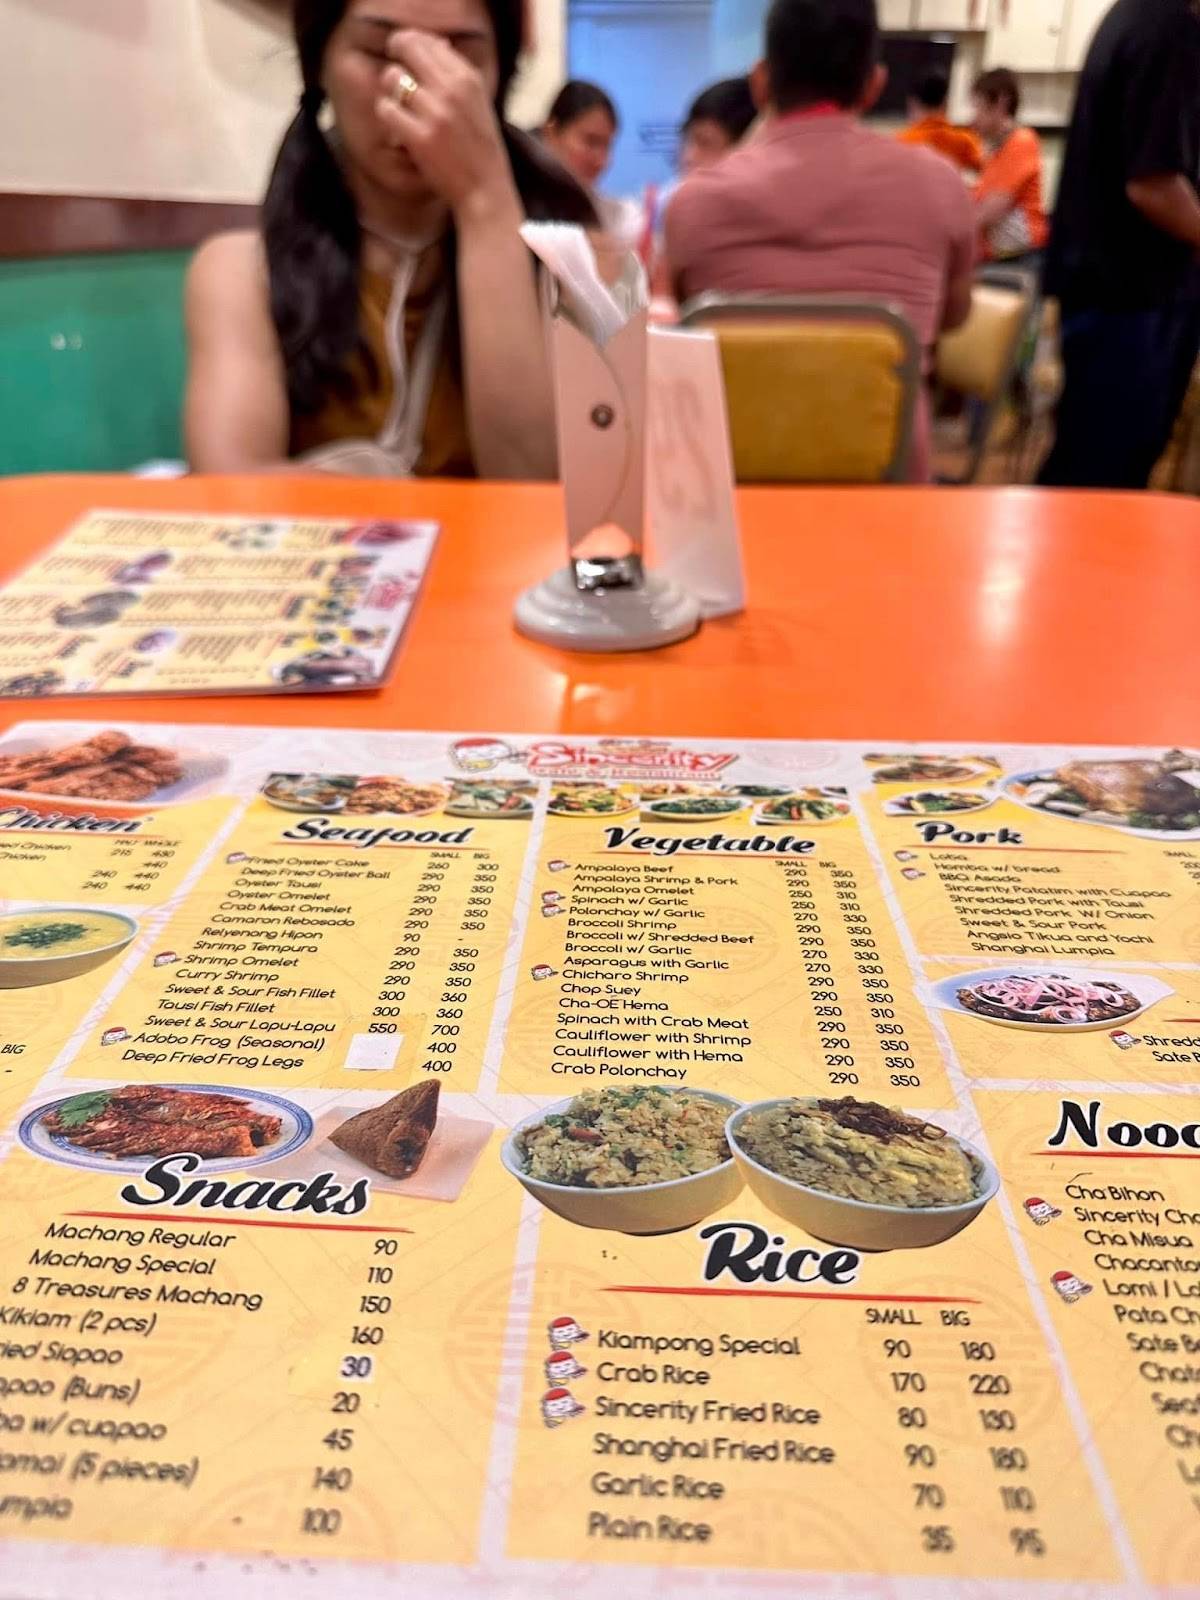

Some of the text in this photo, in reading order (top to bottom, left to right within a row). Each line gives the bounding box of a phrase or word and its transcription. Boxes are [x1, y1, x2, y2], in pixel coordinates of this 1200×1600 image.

[0, 806, 143, 832] Chicken
[283, 819, 474, 850] Seafood
[604, 827, 815, 856] Vegetable
[915, 821, 1022, 844] Pork
[944, 883, 1010, 894] Sincerity
[1075, 888, 1108, 896] with
[219, 901, 352, 914] Crab Meat Omelet
[571, 895, 688, 907] Spinach w/ Garlic
[211, 914, 355, 927] Camaron Rebosado
[569, 906, 705, 918] Polonchay w/ Garlic
[568, 918, 677, 931] Broccoli Shrimp
[960, 917, 1107, 930] Sweet & Sour Pork
[201, 927, 323, 940] Relyenong Hipon
[566, 930, 754, 944] Broccoli w/ Shredded Beef
[193, 940, 318, 954] Shrimp Tempura
[971, 942, 1115, 956] Shanghai Lumpia
[184, 954, 299, 967] Shrimp Omelet
[388, 960, 475, 972] 290 350
[563, 956, 729, 969] Asparagus with Garlic
[175, 969, 279, 983] Curry Shrimp
[562, 969, 689, 984] Chicharo Shrimp
[164, 983, 336, 998] Sweet & Sour Fish Fillet
[378, 991, 467, 1003] 300 360
[560, 983, 641, 997] Chop Suey
[158, 999, 276, 1013] Tausi Fish Fillet
[559, 997, 669, 1011] Cha-OE Hema
[144, 1015, 336, 1034] Sweet & Sour Lapu-Lapu
[368, 1023, 460, 1036] 550 700
[557, 1012, 749, 1029] Spinach with Crab Meat
[133, 1032, 325, 1052] Adobo Frog (Seasonal)
[555, 1028, 752, 1048] Cauliflower with Shrimp
[121, 1049, 304, 1070] Deep Fried Frog Legs
[553, 1045, 743, 1062] Cauliflower with Hema
[1152, 1051, 1192, 1063] Sate
[551, 1062, 687, 1080] Crab Polonchay
[828, 1072, 920, 1087] 290 350
[121, 1155, 370, 1215] Snacks
[1065, 1185, 1165, 1201] Cha Bihon
[1074, 1206, 1159, 1227] Sincerity
[44, 1222, 237, 1249] Machang Regular
[1084, 1229, 1194, 1248] Cha Misua
[374, 1239, 398, 1256] 90
[700, 1222, 859, 1285] Rice
[28, 1249, 216, 1275] Machang Special
[368, 1267, 393, 1284] 110
[12, 1276, 263, 1312] 8 Treasures Machang
[1102, 1278, 1158, 1297] Lomi
[360, 1296, 391, 1314] 150
[1113, 1304, 1168, 1324] Pata
[79, 1309, 104, 1334] (2
[102, 1312, 157, 1337] pcs)
[865, 1308, 971, 1327] SMALL BIG
[351, 1326, 384, 1345] 160
[598, 1330, 801, 1357] Kiampong Special
[42, 1341, 123, 1368] Siopao
[883, 1339, 996, 1361] 90 180
[341, 1356, 372, 1378] 30
[596, 1362, 711, 1385] Crab Rice
[61, 1375, 141, 1406] (Buns)
[890, 1372, 1011, 1396] 170 220
[331, 1392, 361, 1414] 20
[595, 1396, 821, 1425] Sincerity Fried Rice
[898, 1406, 1016, 1432] 80 130
[66, 1418, 167, 1443] cuapao
[322, 1429, 354, 1451] 45
[593, 1432, 836, 1464] Shanghai Fried Rice
[904, 1444, 1028, 1472] 90 180
[312, 1467, 352, 1492] 140
[591, 1471, 725, 1500] Garlic Rice
[913, 1483, 1036, 1513] 70 110
[588, 1511, 713, 1544] Plain Rice
